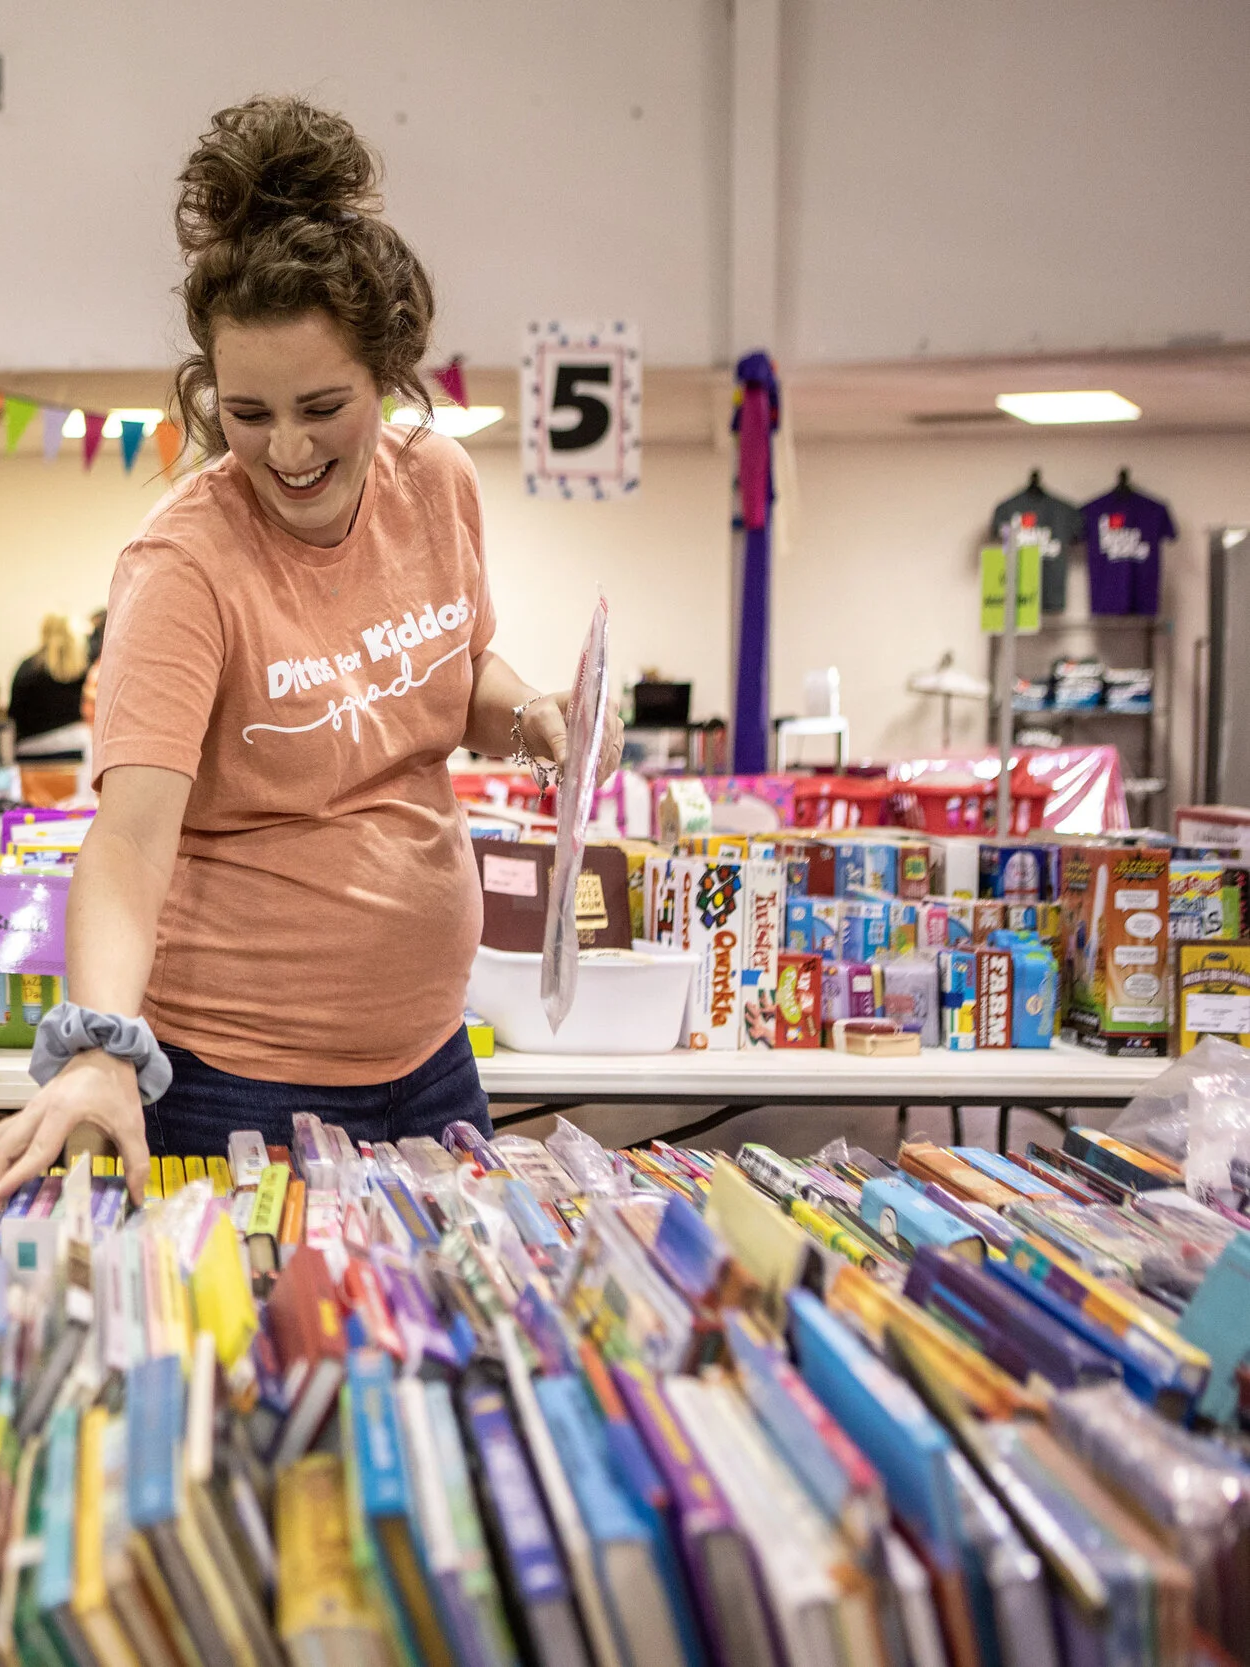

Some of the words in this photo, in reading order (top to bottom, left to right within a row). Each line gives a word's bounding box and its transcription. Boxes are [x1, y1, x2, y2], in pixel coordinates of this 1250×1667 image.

[549, 362, 612, 451] 5
[267, 656, 337, 699] Dittos
[361, 596, 469, 663] Kiddos
[754, 891, 777, 973] Twister
[711, 929, 737, 1028] Qwirkle
[988, 955, 1008, 1046] FARM
